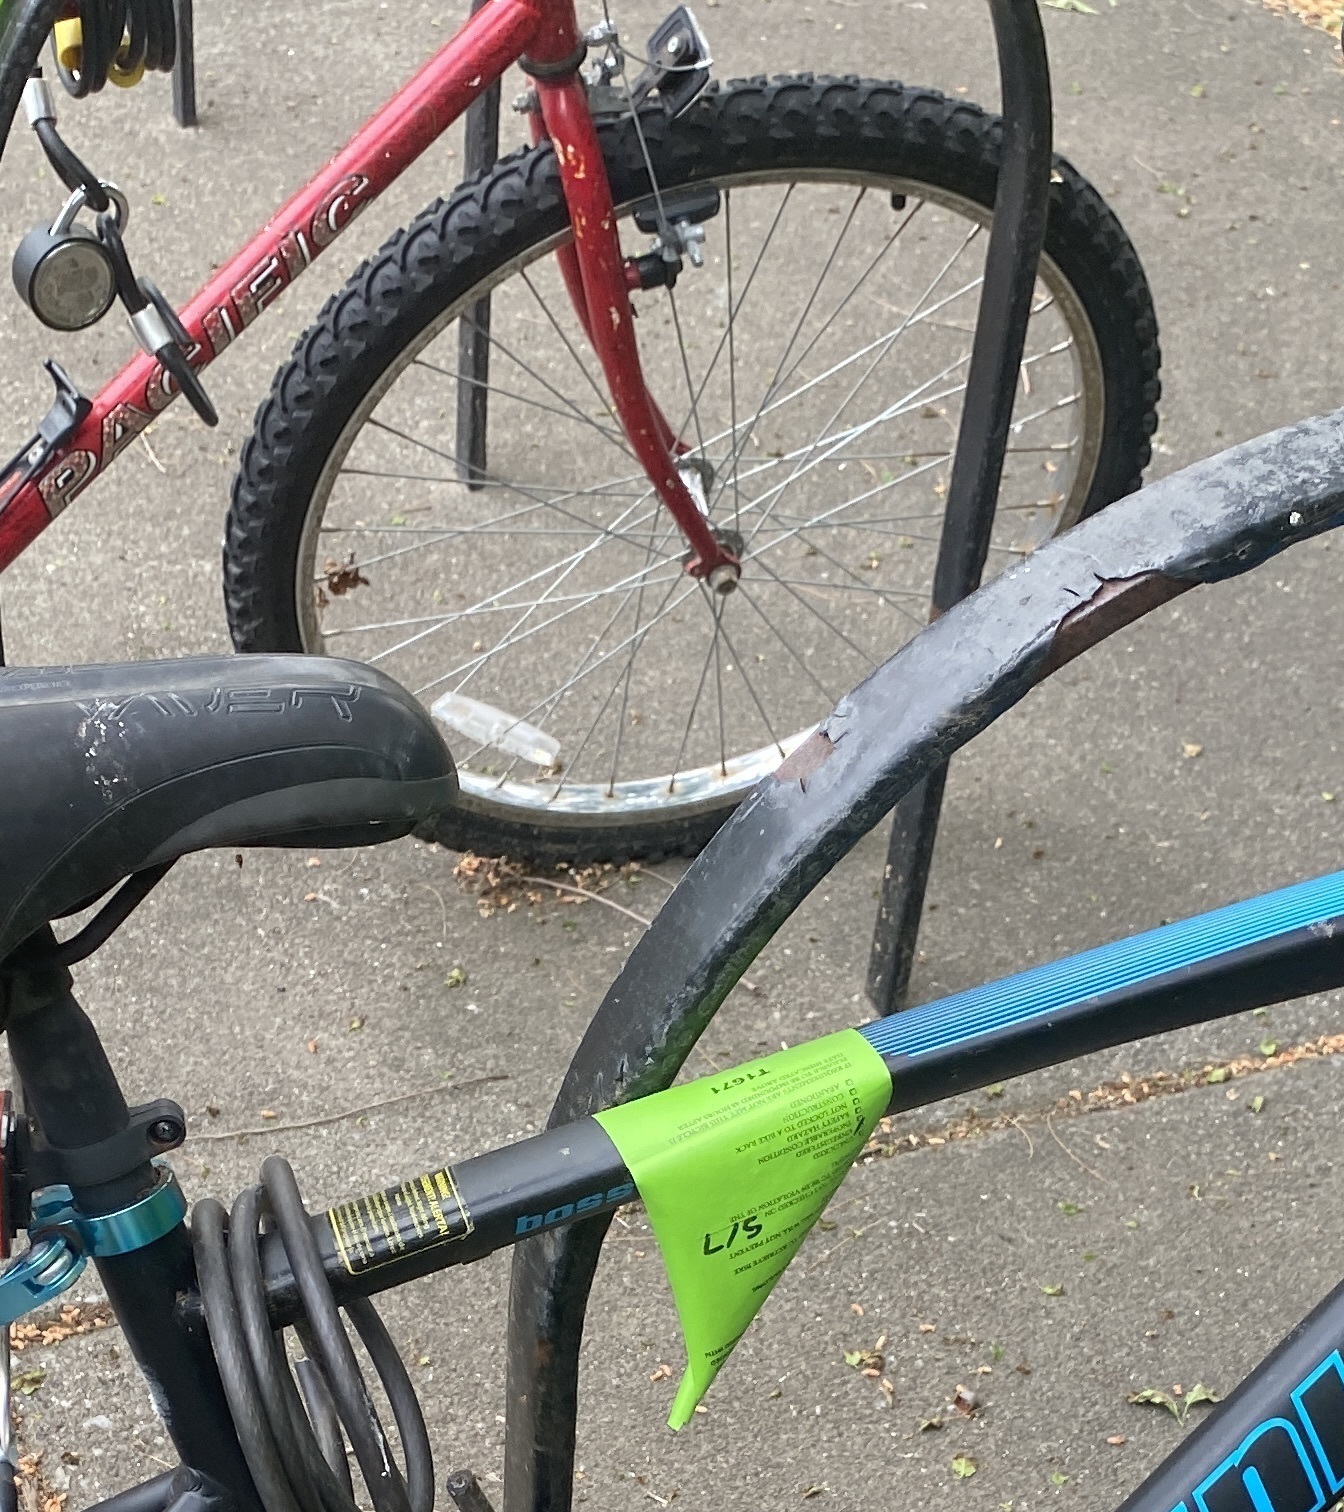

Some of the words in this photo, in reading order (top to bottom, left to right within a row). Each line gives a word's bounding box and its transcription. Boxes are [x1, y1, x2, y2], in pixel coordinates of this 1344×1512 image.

[29, 165, 379, 519] PACIFIC
[710, 1064, 771, 1096] T1671
[750, 1077, 778, 1093] ABOVE
[782, 1064, 842, 1094] REQUIREMENTS
[740, 1079, 789, 1104] IMPOUNDED
[766, 1091, 781, 1101] ARE
[789, 1082, 840, 1109] ABANDONED
[702, 1104, 731, 1120] HOURS
[747, 1098, 766, 1110] NOT
[781, 1091, 844, 1123] CONSTRUCTION
[829, 1101, 847, 1114] NOT
[676, 1116, 702, 1131] AFTER
[708, 1114, 728, 1127] THIS
[796, 1109, 829, 1128] LOCKED
[820, 1111, 849, 1127] SAFETY
[675, 1122, 709, 1142] BICYCLE
[776, 1128, 783, 1136] A
[783, 1123, 795, 1133] TO
[785, 1123, 820, 1142] HAZARD
[802, 1120, 851, 1145] INOPERABLE
[667, 1136, 676, 1145] IS
[757, 1131, 776, 1144] BIKE
[794, 1128, 853, 1158] UNREGISTERED
[734, 1139, 757, 1154] RACK
[756, 1140, 804, 1164] CONDITION
[757, 1187, 800, 1211] VIOLATION
[776, 1190, 814, 1211] CHECKED
[728, 1211, 744, 1223] THE
[744, 1205, 757, 1215] OF
[763, 1207, 777, 1217] ON
[764, 1231, 782, 1244] NOT
[727, 1238, 765, 1261] PREVENT
